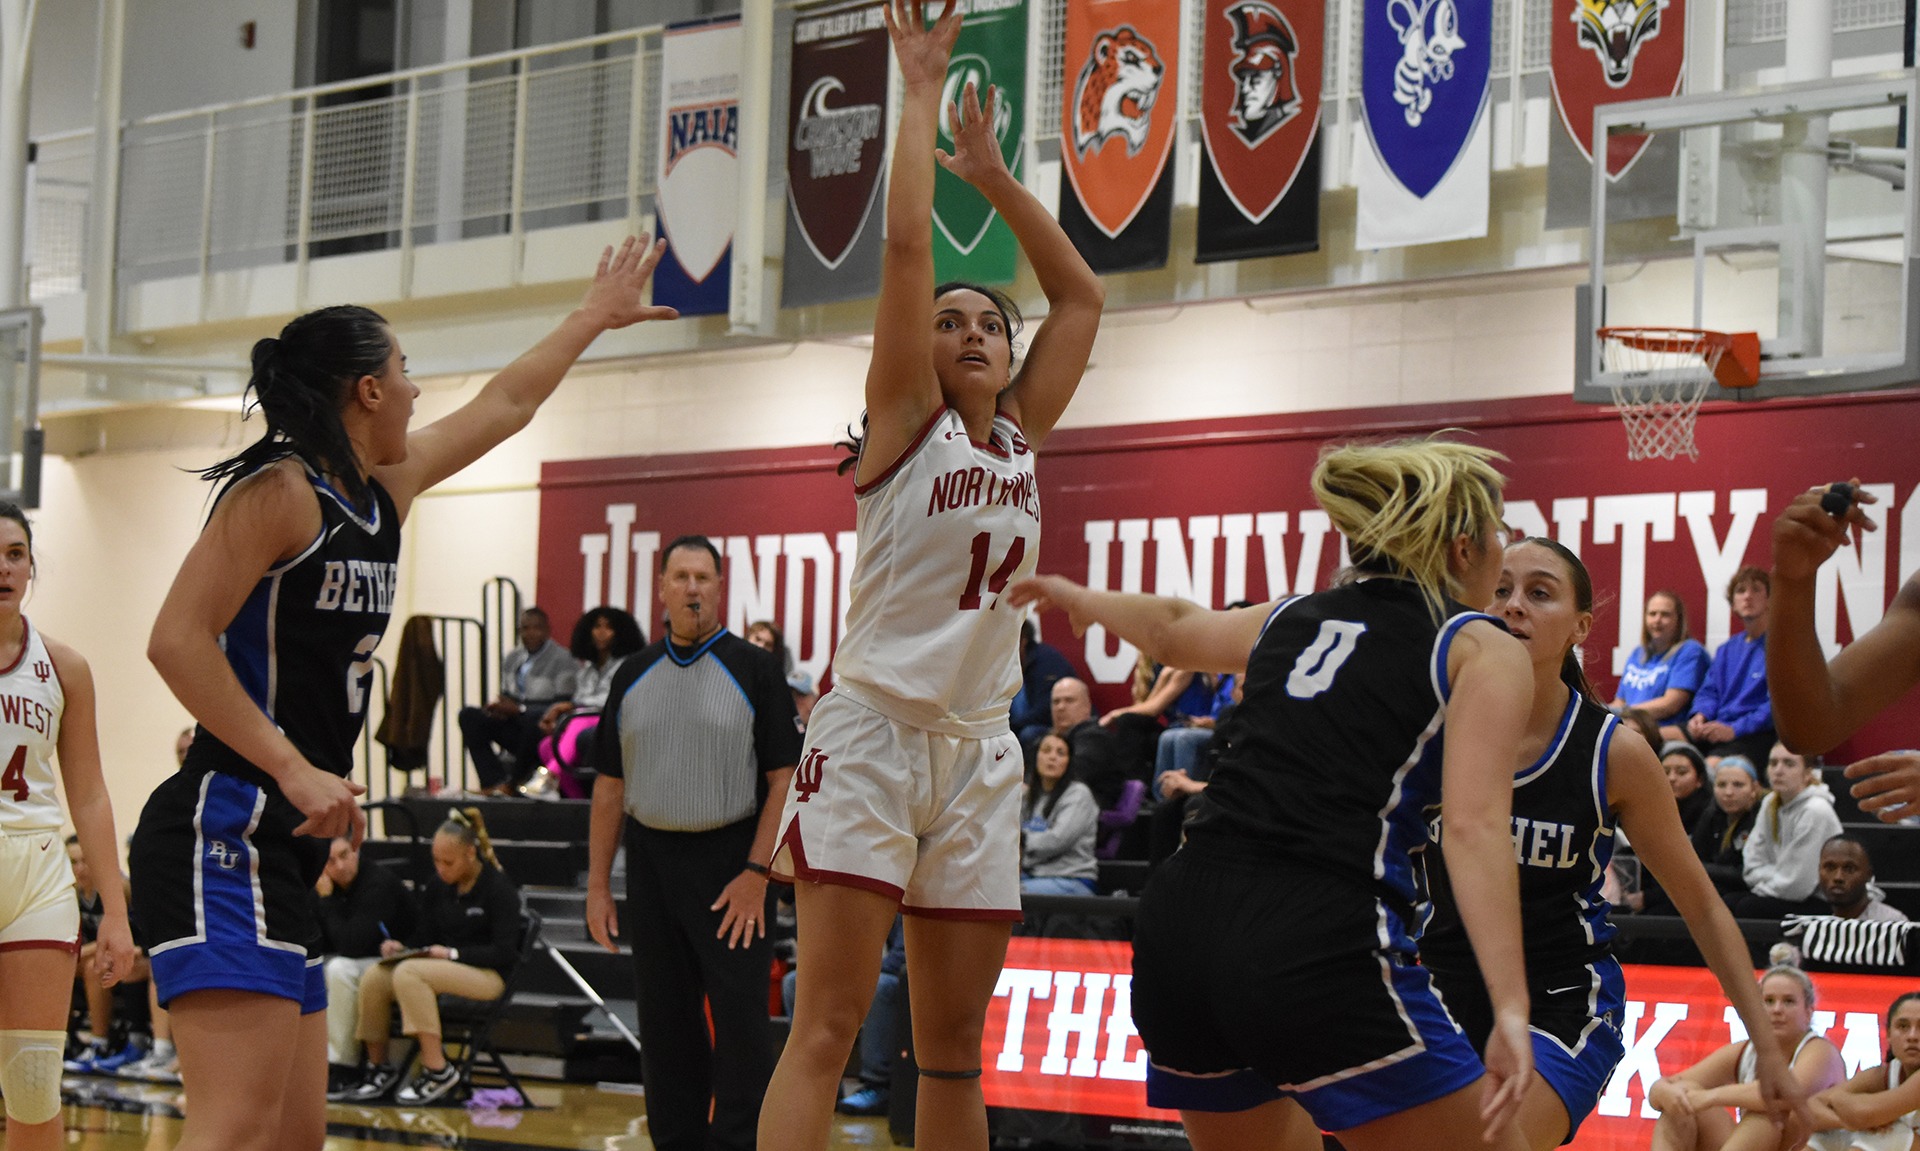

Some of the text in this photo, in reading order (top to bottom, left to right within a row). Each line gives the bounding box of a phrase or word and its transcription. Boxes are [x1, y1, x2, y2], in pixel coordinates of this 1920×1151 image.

[670, 106, 738, 159] NAIA
[1084, 488, 1768, 684] UNIVITY
[1285, 619, 1369, 700] 0
[0, 693, 54, 741] WEST
[1, 744, 31, 802] 4
[992, 967, 1148, 1083] THE
